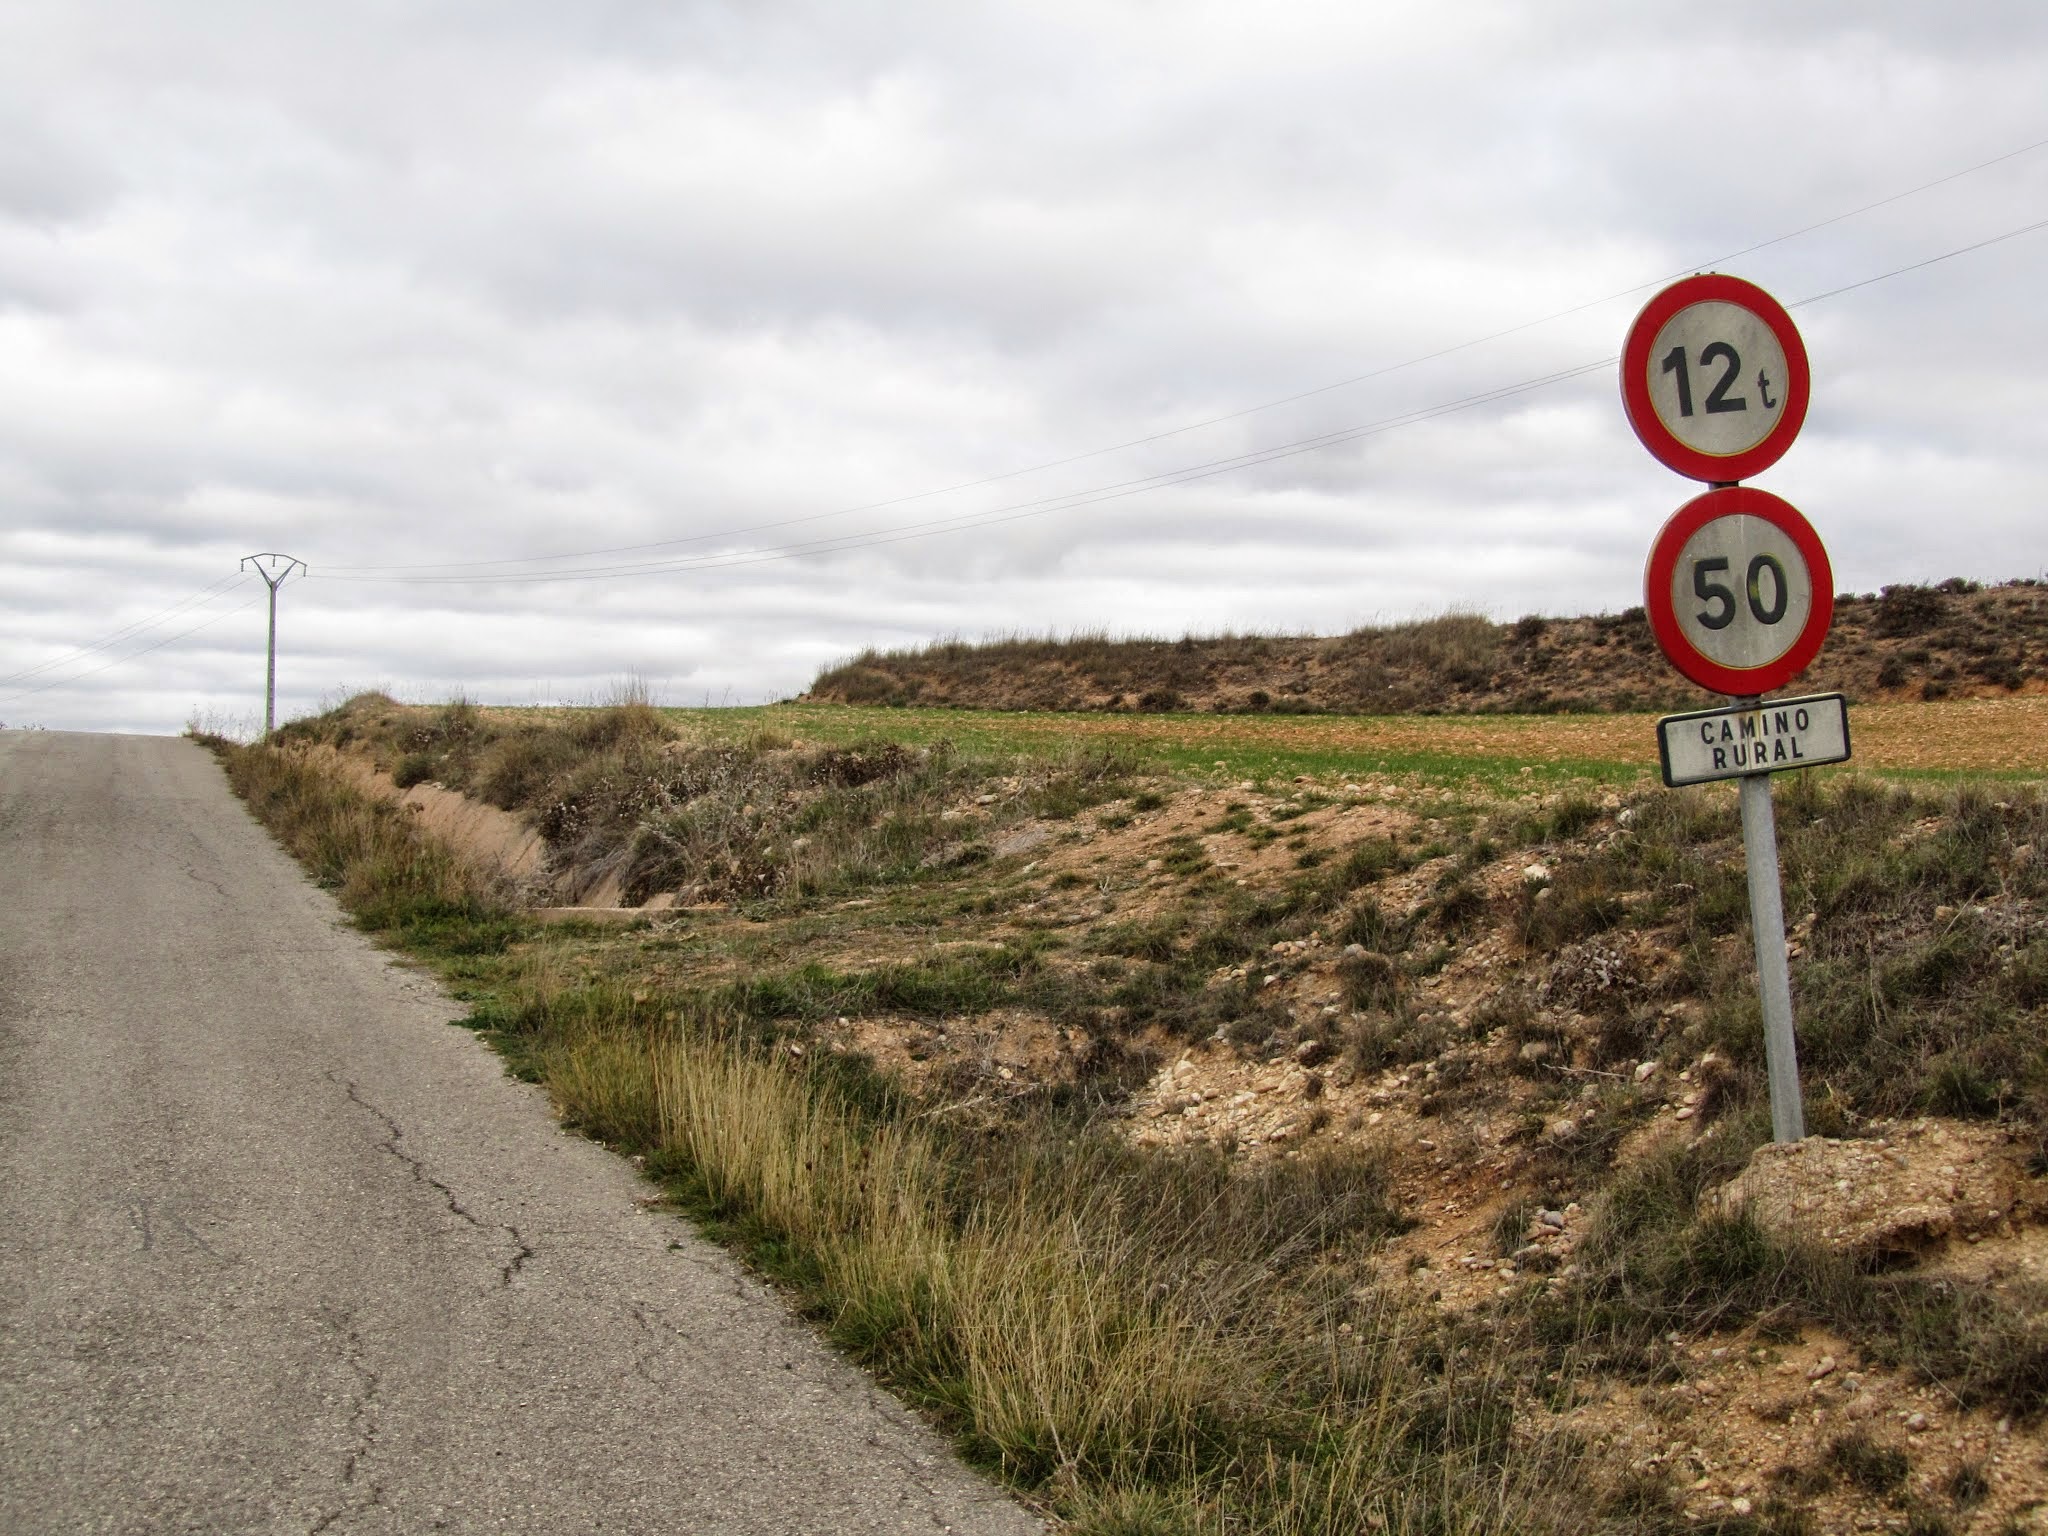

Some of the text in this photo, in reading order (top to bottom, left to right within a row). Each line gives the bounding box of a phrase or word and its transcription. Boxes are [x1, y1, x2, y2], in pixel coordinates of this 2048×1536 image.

[1661, 342, 1777, 417] 12 t
[1693, 553, 1788, 630] 50
[1700, 708, 1809, 745] CAMINO
[1713, 737, 1803, 769] RURAL
